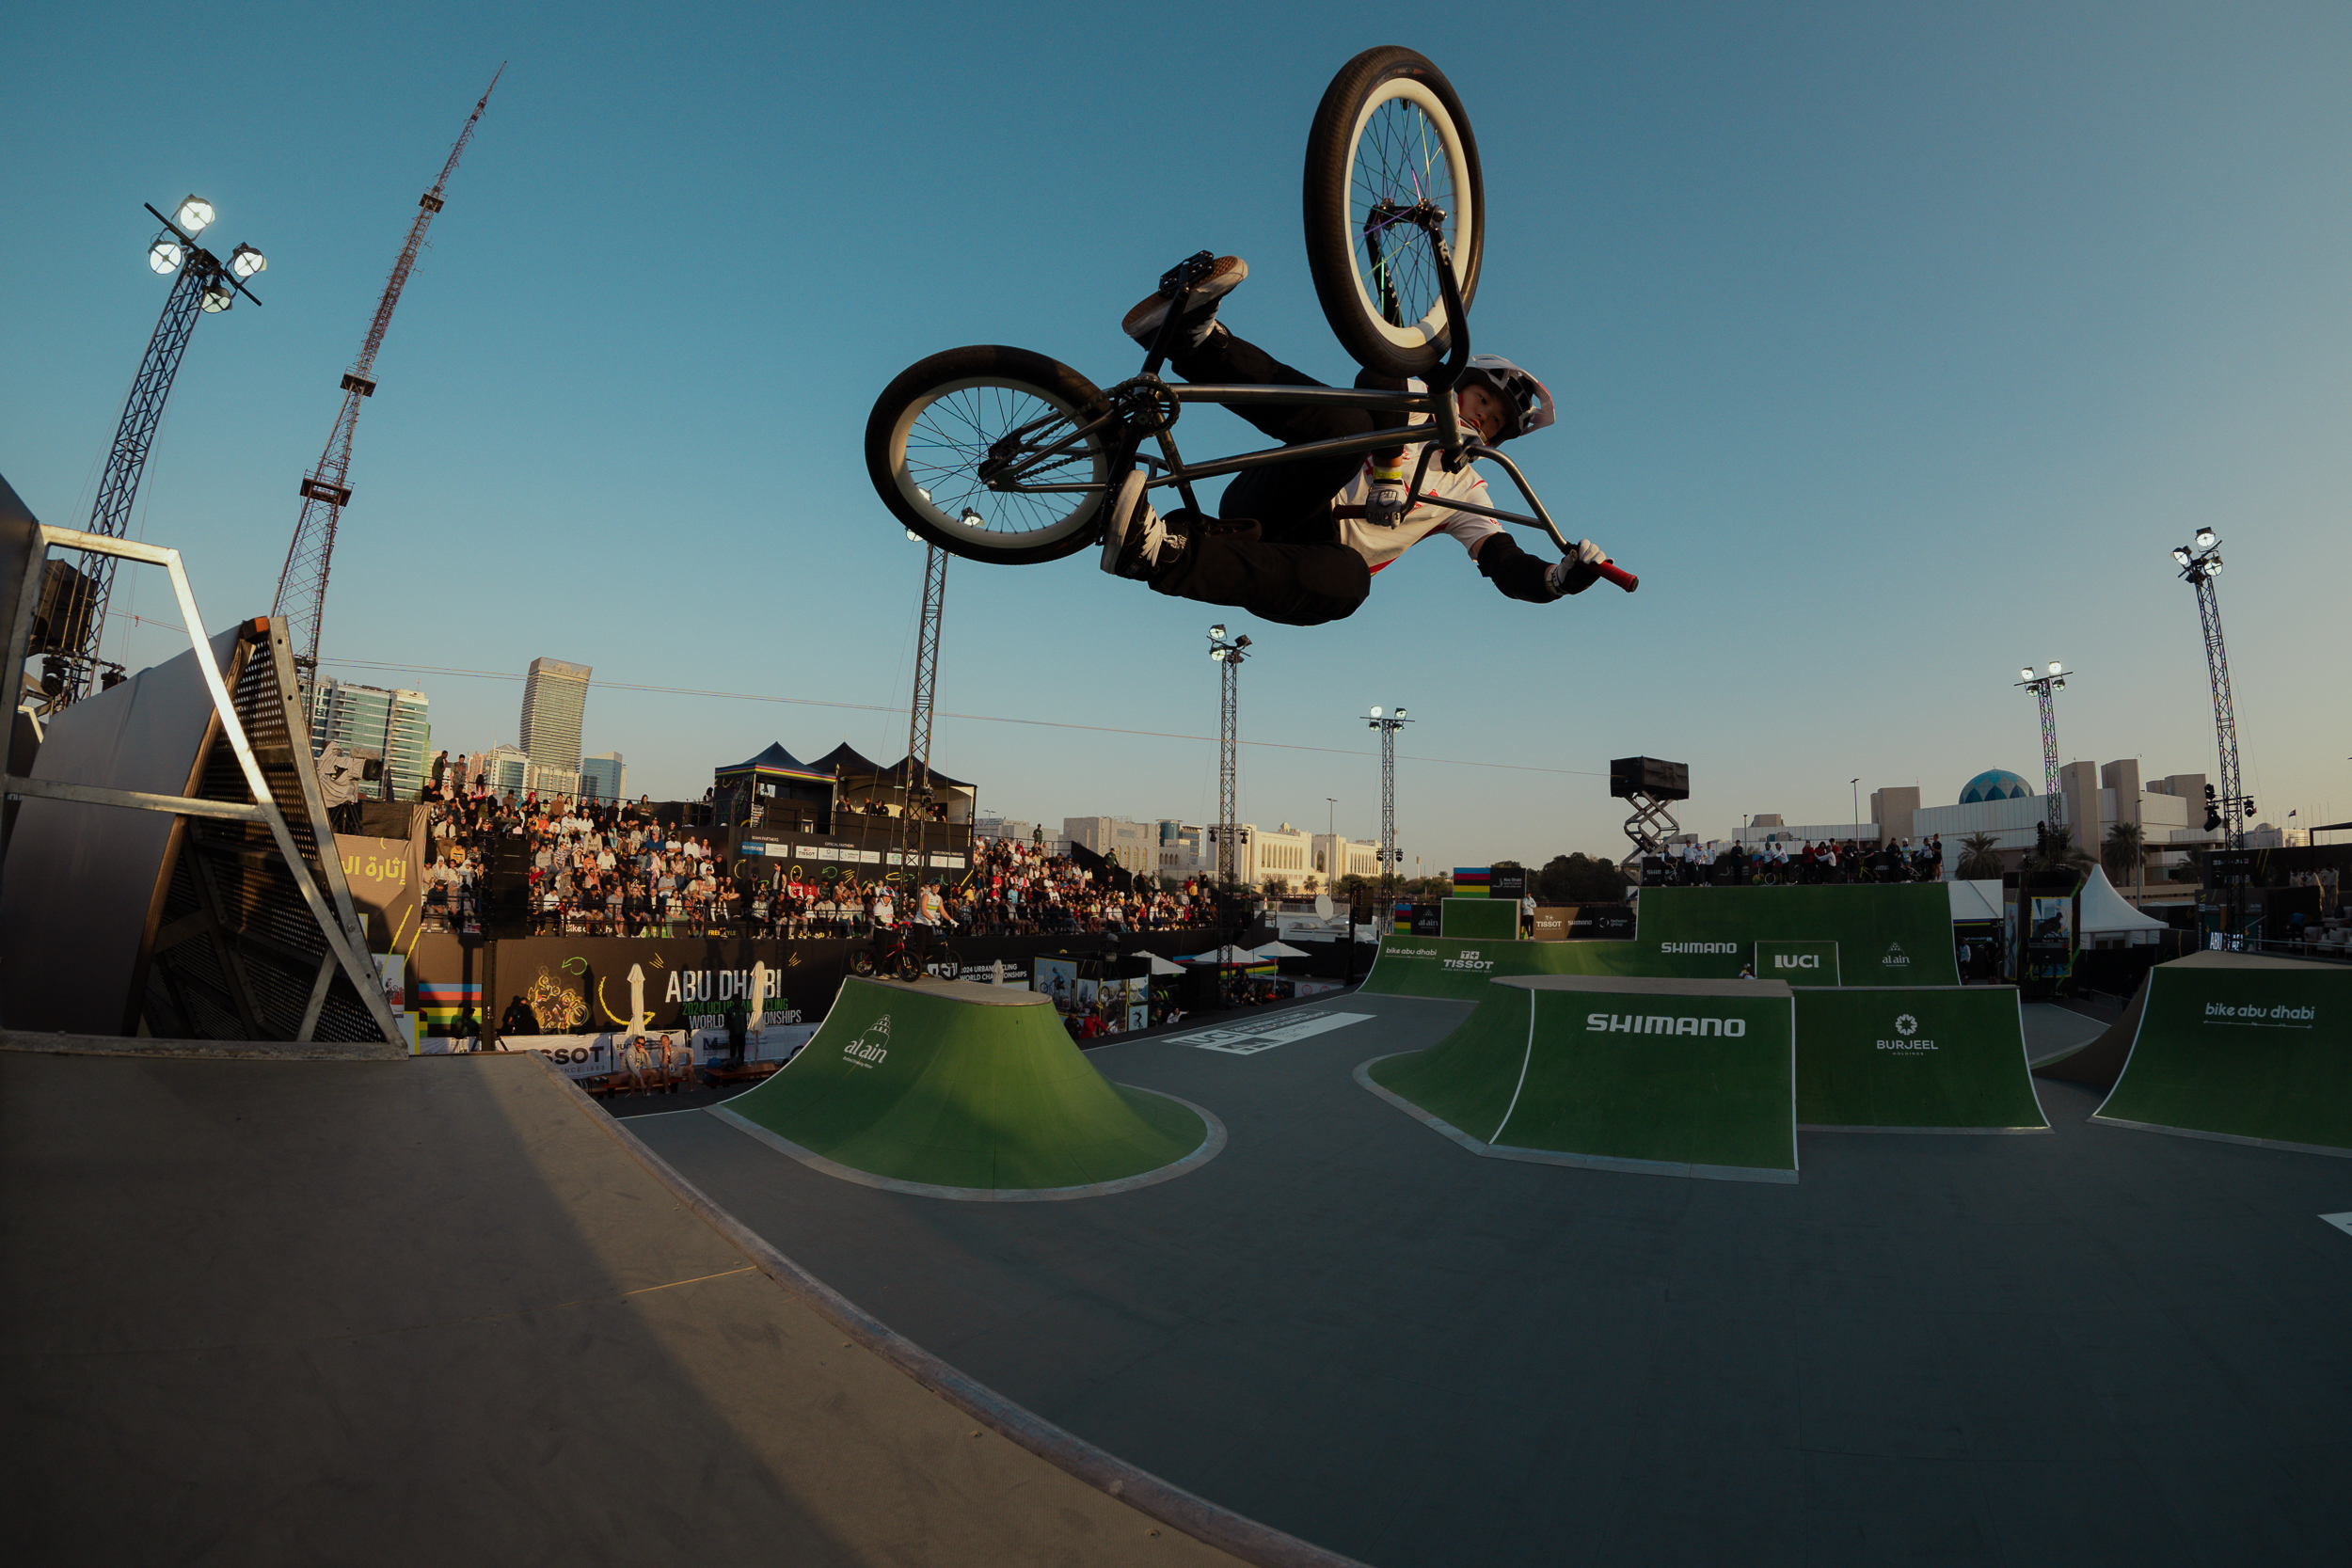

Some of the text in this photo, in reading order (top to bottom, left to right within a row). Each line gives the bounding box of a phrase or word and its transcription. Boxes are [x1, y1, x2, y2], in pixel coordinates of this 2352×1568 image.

[365, 856, 406, 886] إثارة
[1418, 918, 1438, 927] al ain
[1661, 942, 1738, 954] SHIMANO
[2209, 931, 2223, 951] ABU
[1443, 959, 1494, 970] TISSOT
[1774, 955, 1820, 968] UCI
[1882, 955, 1911, 964] al ain
[981, 971, 1027, 980] CHAONSHIPS
[665, 969, 782, 1003] ABU DHBI
[682, 1002, 705, 1016] 2024
[2205, 1002, 2315, 1020] bike abu dhabi
[689, 1014, 725, 1030] WORLD
[1585, 1013, 1746, 1037] SHIMANO
[844, 1038, 887, 1064] al ain
[1876, 1039, 1939, 1050] BURJEEL
[539, 1046, 605, 1065] SSOT
